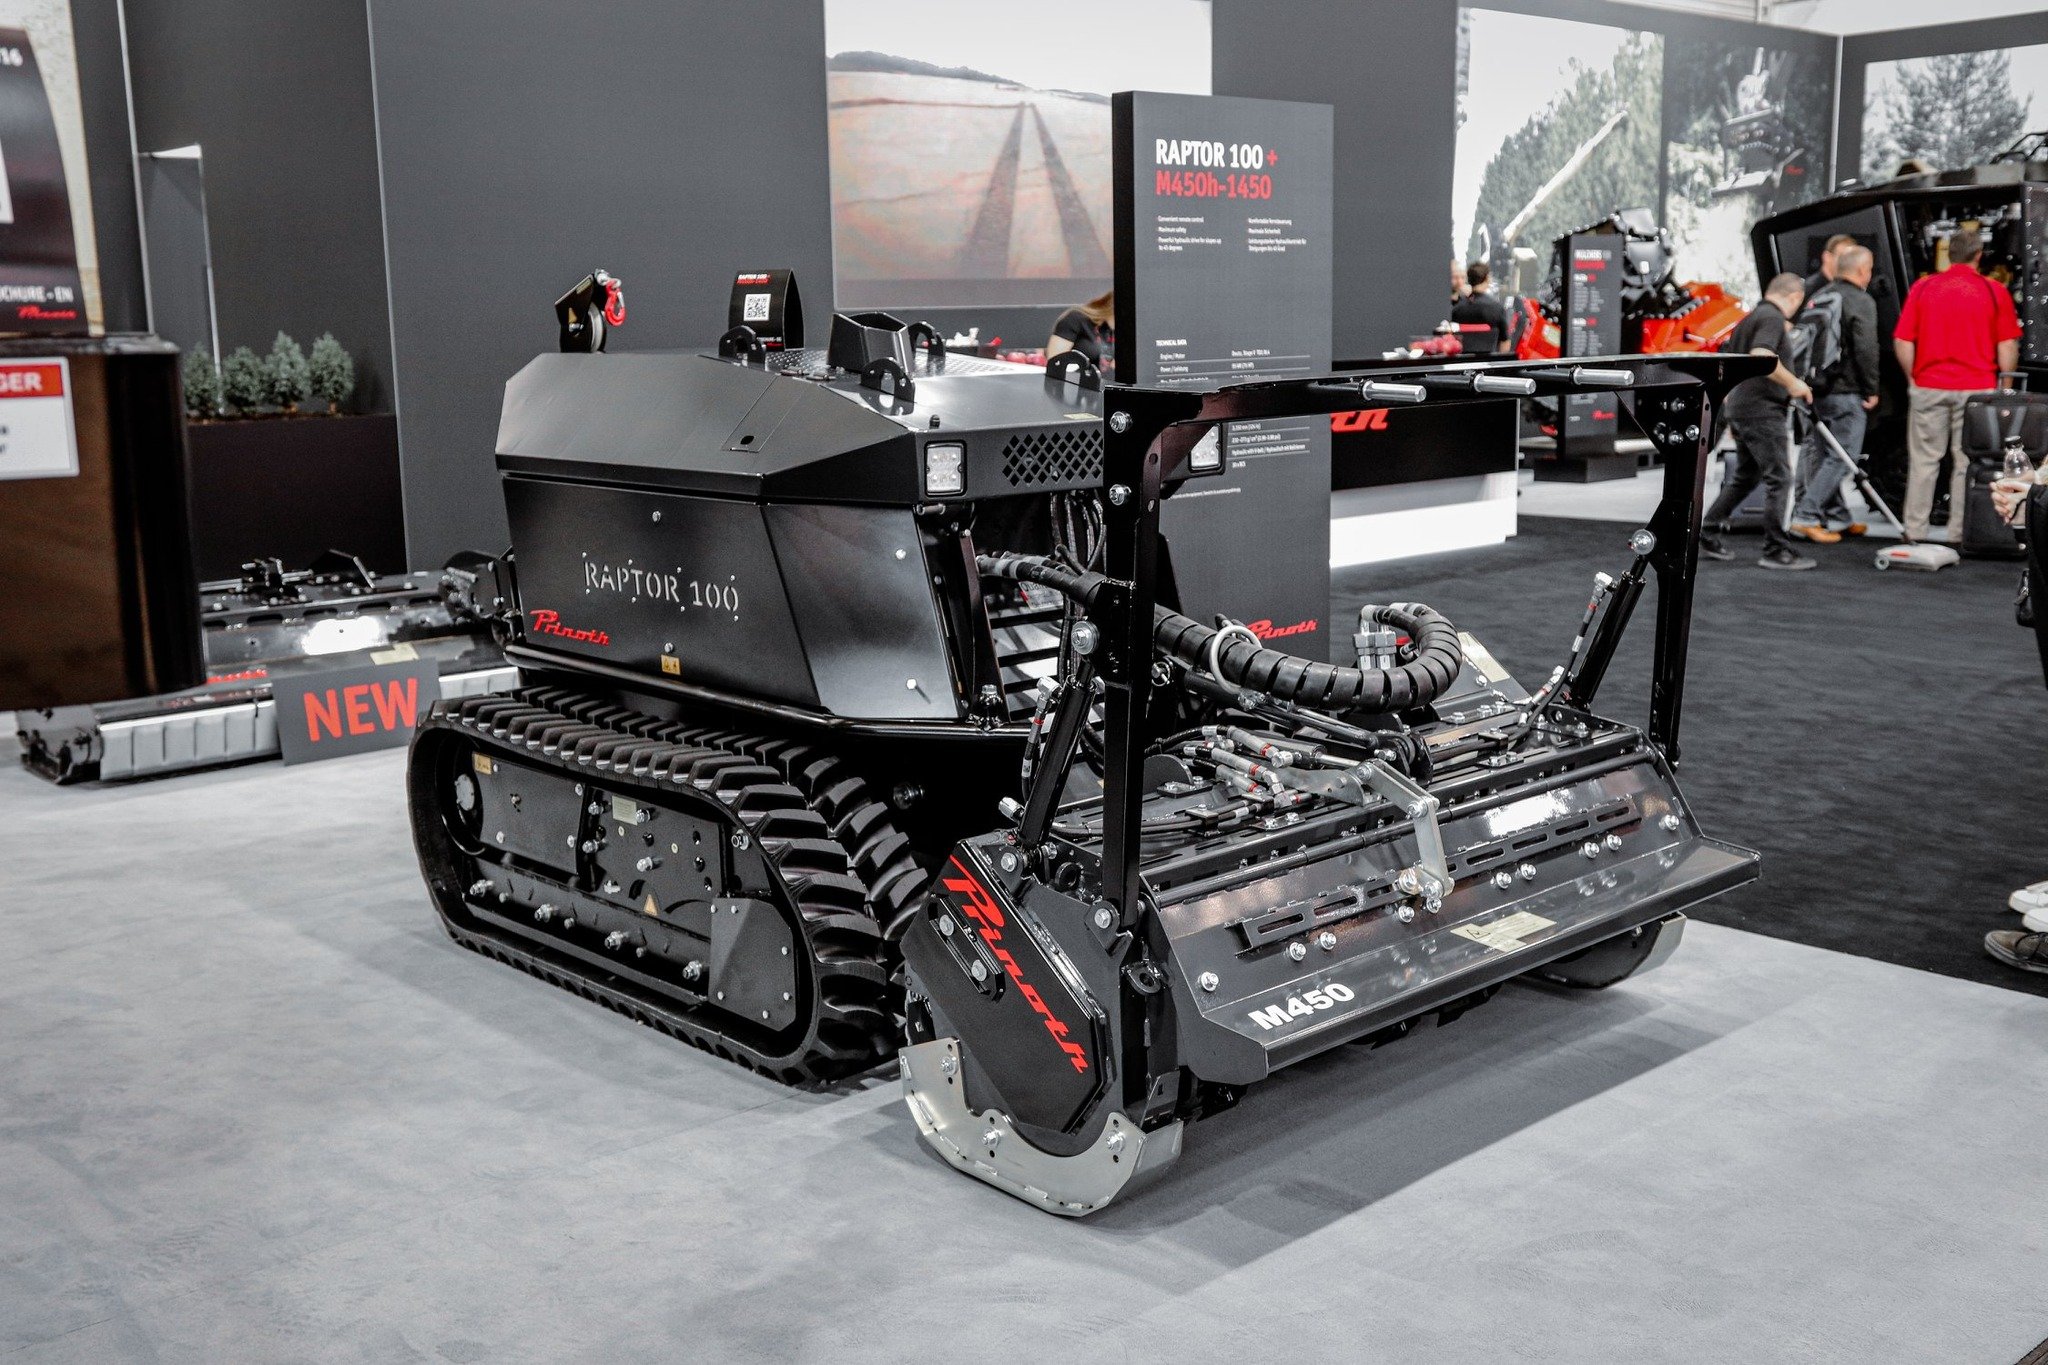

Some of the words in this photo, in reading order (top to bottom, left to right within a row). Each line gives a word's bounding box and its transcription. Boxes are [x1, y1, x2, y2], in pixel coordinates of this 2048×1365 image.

[1156, 139, 1225, 168] RAPTOR
[1230, 143, 1264, 169] 100
[1156, 170, 1272, 200] M450h-1450
[584, 561, 680, 603] RAPTOR
[689, 580, 739, 612] 100
[530, 608, 610, 646] Prinoth
[304, 678, 418, 741] NEW
[942, 854, 1091, 1074] Prinoth
[1248, 982, 1356, 1031] M450
